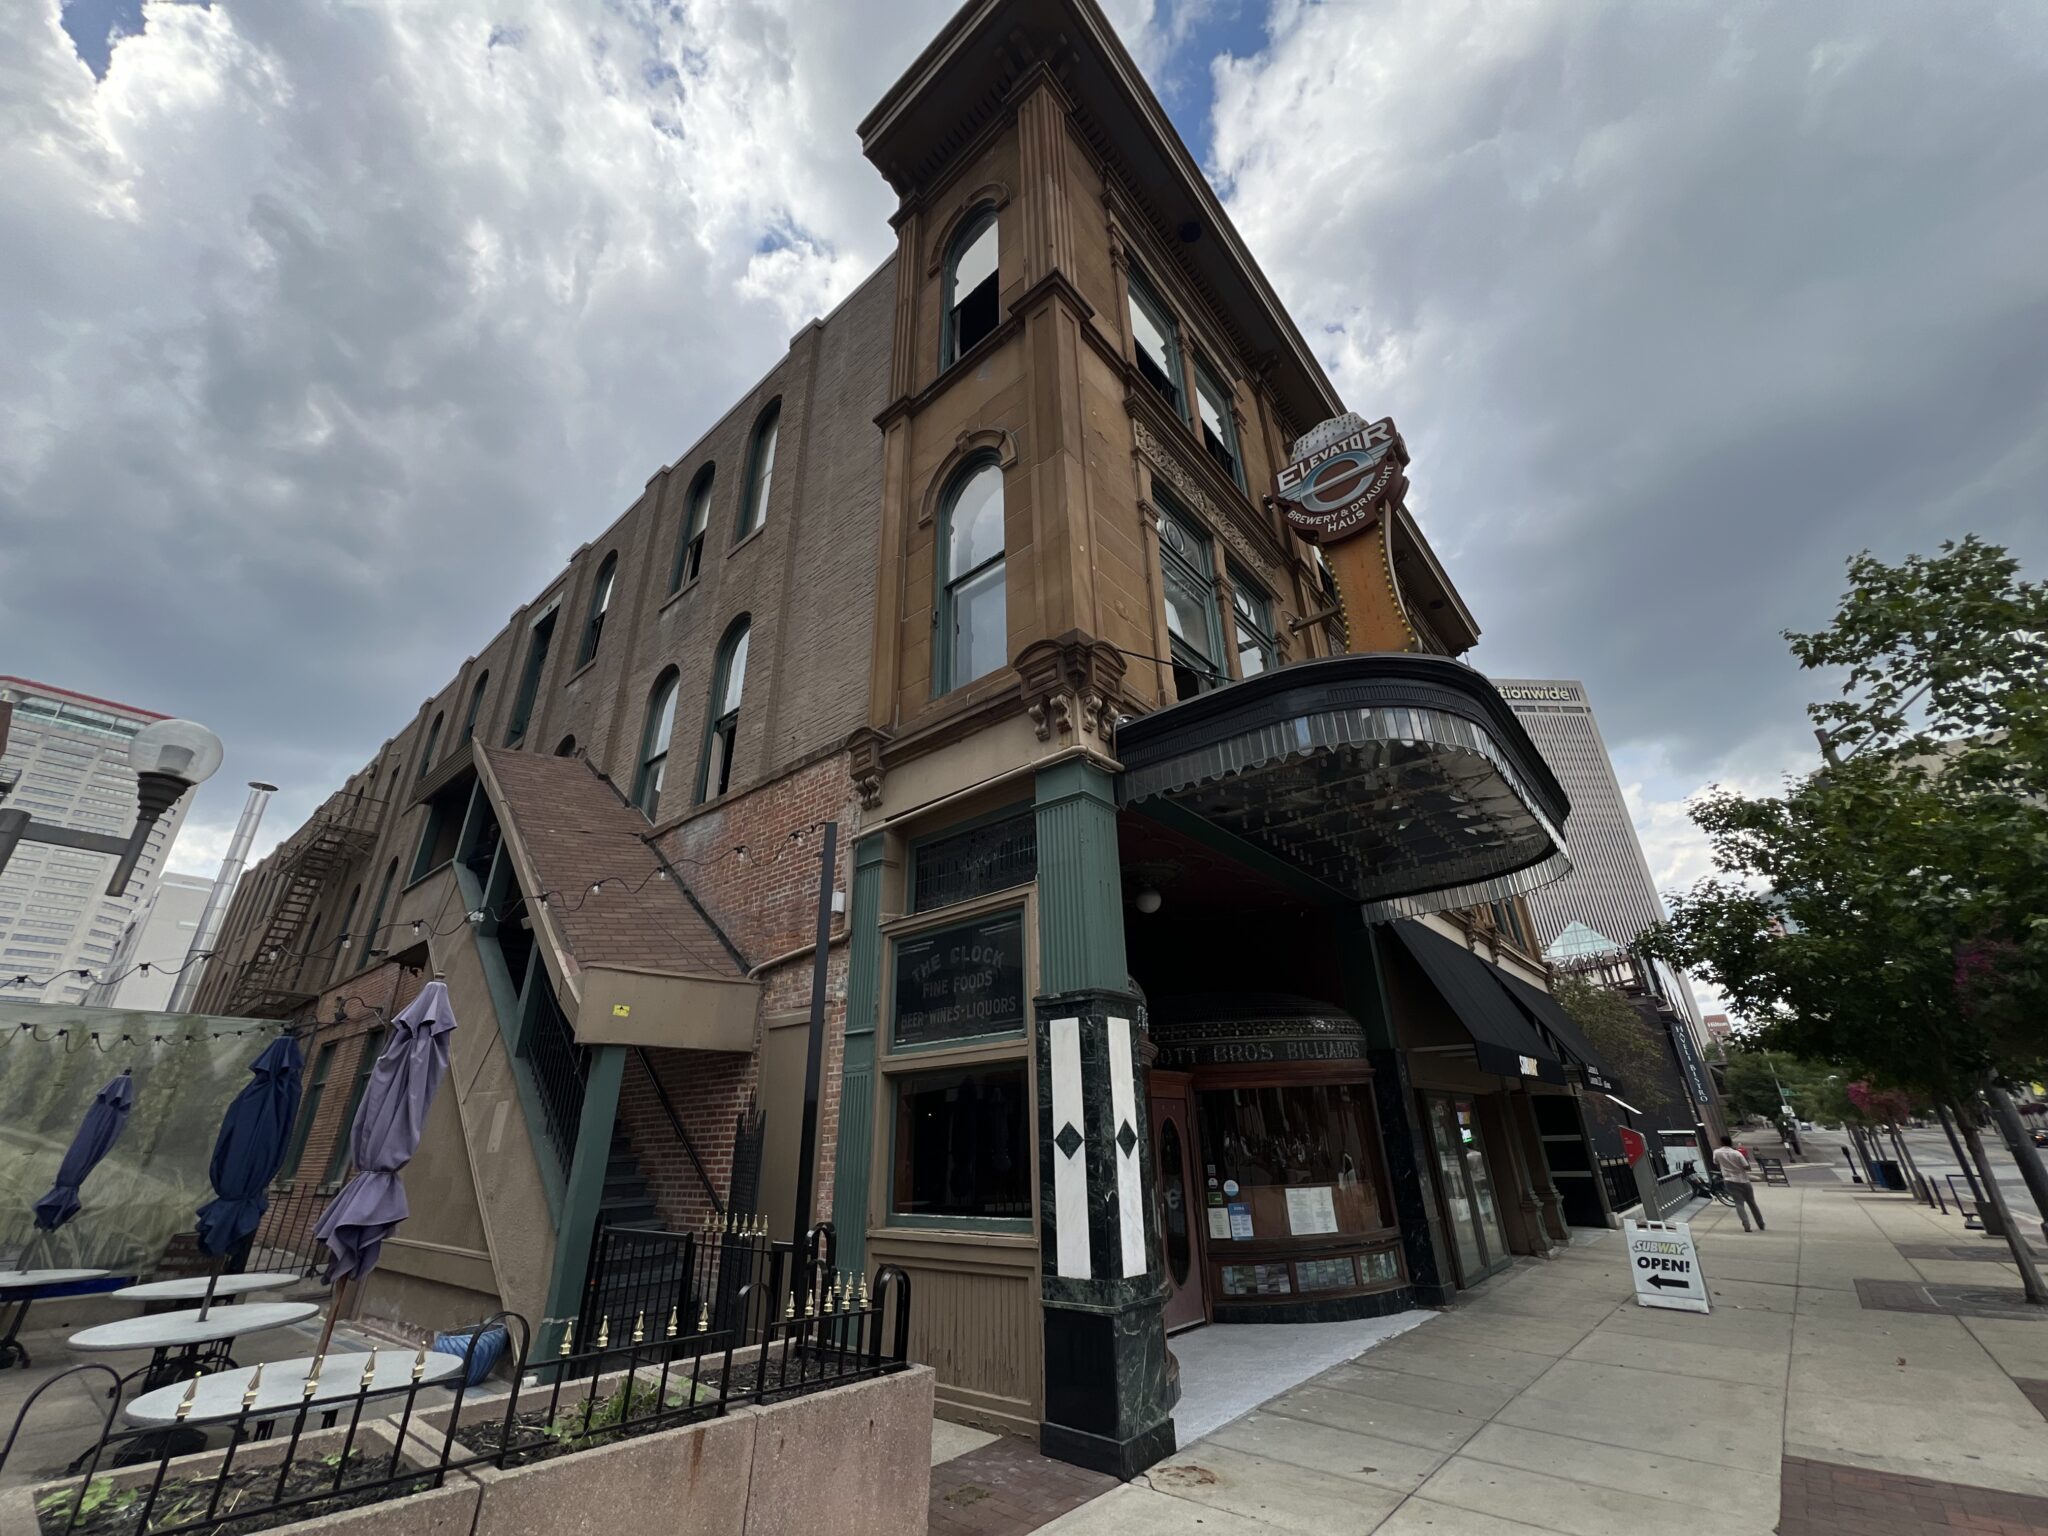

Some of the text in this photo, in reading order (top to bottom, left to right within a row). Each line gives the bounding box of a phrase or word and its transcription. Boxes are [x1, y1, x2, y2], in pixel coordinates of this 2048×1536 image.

[1277, 422, 1393, 492] ELEVATOR
[1287, 465, 1395, 525] BREWERY & DRAUGHT
[1327, 510, 1367, 533] HAUS
[1498, 686, 1570, 701] tionwide
[911, 945, 1004, 983] THE CLOCK
[922, 970, 994, 998] FINE FOODS
[1157, 1041, 1361, 1066] OTT BROS BILLIARDS
[1689, 1064, 1709, 1102] BISTRO
[1632, 1240, 1690, 1256] SUBWAY
[1637, 1256, 1691, 1273] OPEN!
